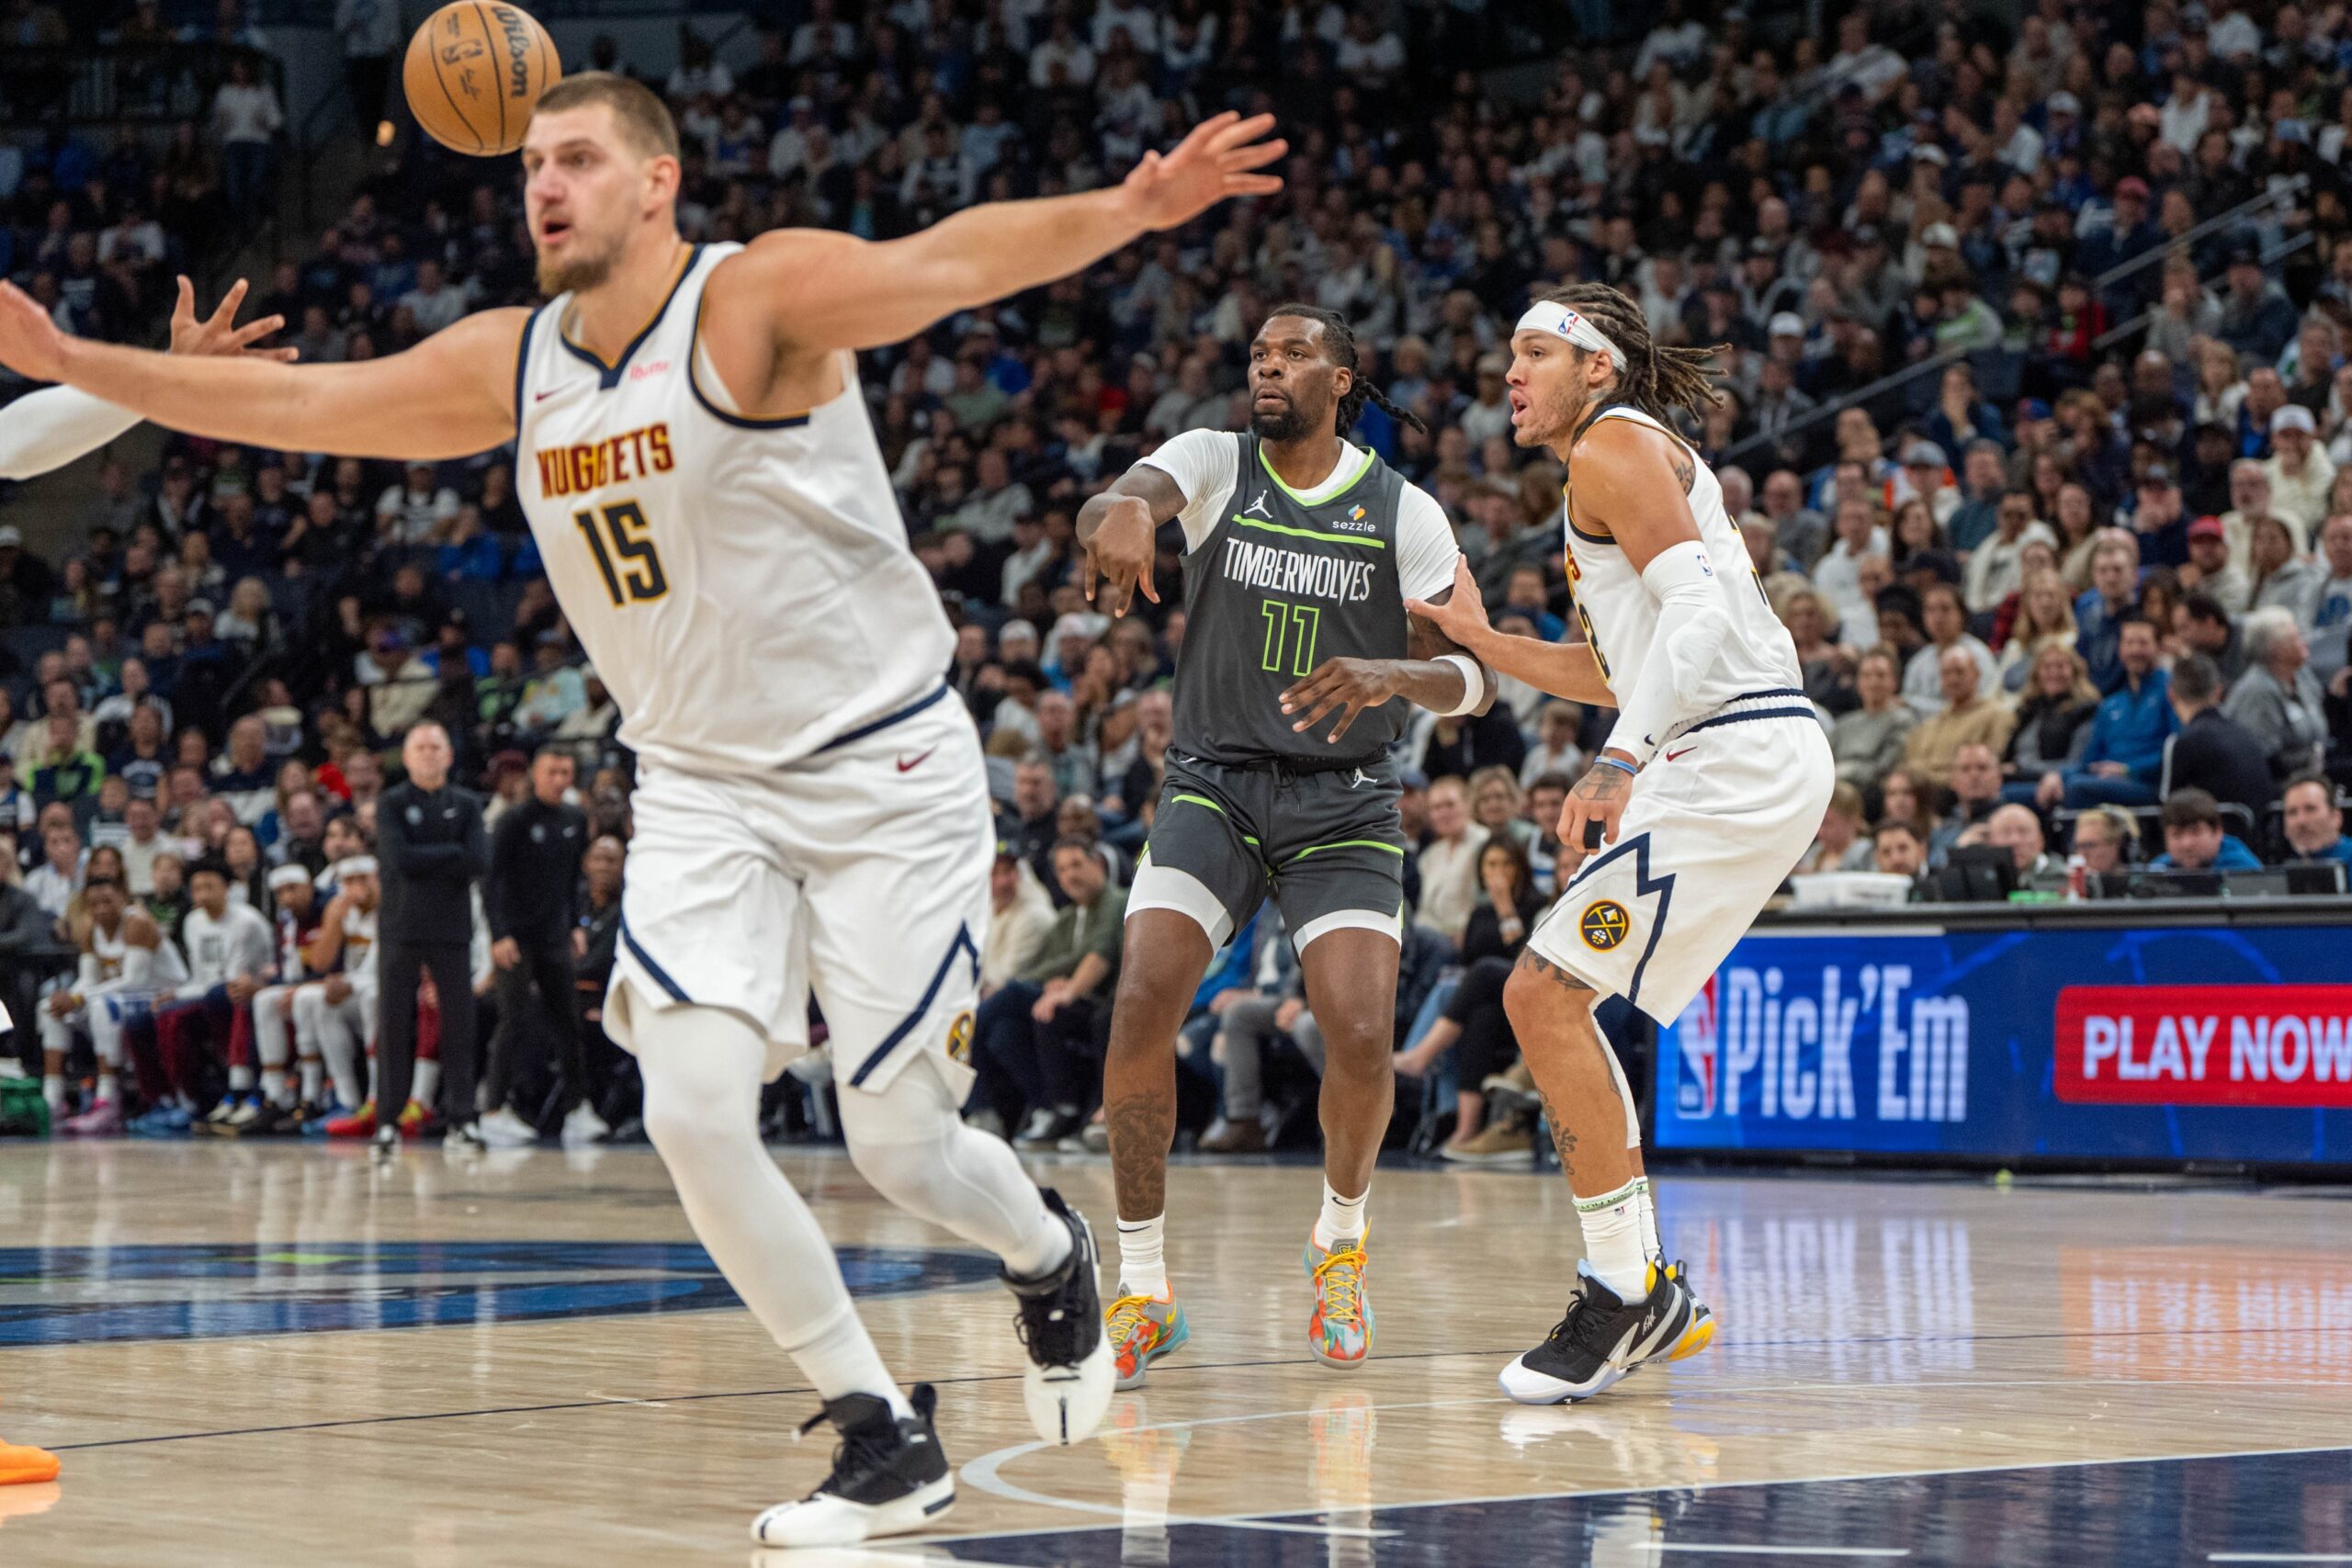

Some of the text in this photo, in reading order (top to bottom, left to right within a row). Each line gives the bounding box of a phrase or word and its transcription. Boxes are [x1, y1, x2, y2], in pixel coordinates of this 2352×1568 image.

[491, 6, 530, 96] Wilson
[573, 500, 670, 608] 15
[1332, 520, 1376, 533] sezzle
[1224, 536, 1376, 607] TIMBERWOLVES
[1261, 599, 1320, 677] 11
[1724, 965, 1968, 1122] Pick'Em
[2082, 1014, 2352, 1084] PLAY NOW
